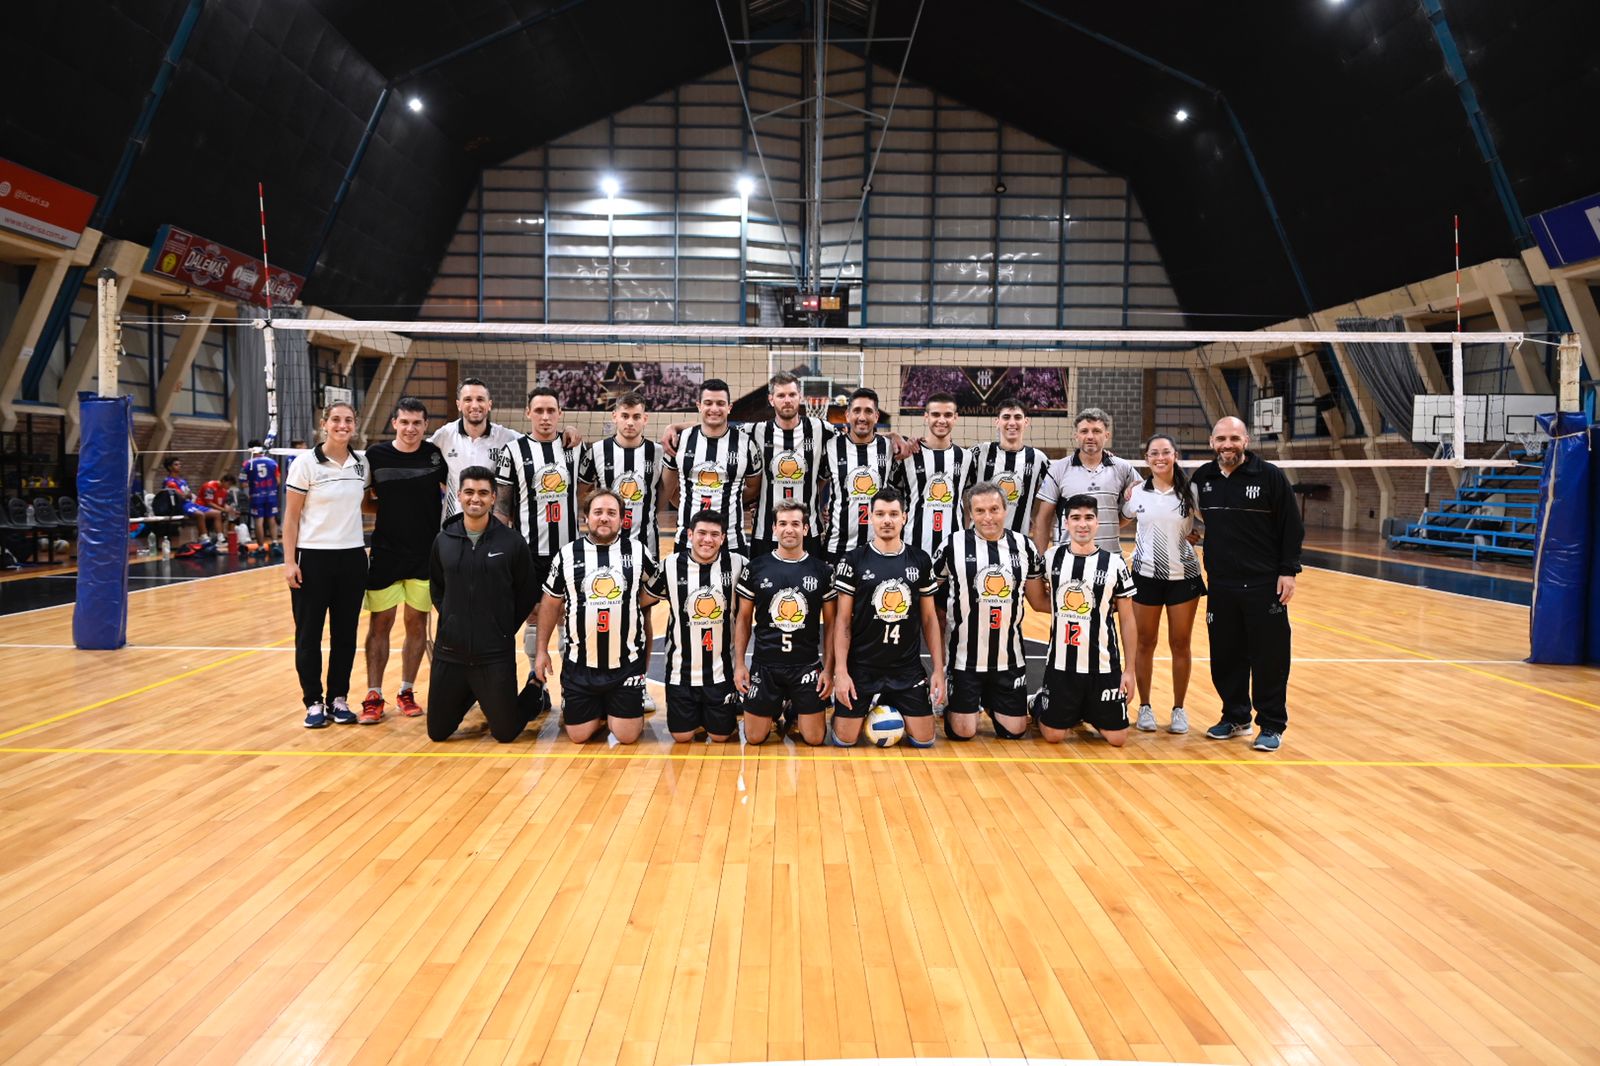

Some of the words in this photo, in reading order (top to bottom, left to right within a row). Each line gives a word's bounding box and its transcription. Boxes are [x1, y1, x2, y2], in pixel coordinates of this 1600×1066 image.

[184, 251, 229, 279] DALEMAS
[256, 463, 268, 478] 5
[545, 503, 561, 523] 10
[858, 505, 869, 525] 2
[597, 610, 610, 633] 9
[990, 608, 1002, 629] 3
[701, 630, 714, 652] 4
[781, 633, 793, 653] 5
[882, 624, 901, 645] 14
[1064, 623, 1082, 647] 12
